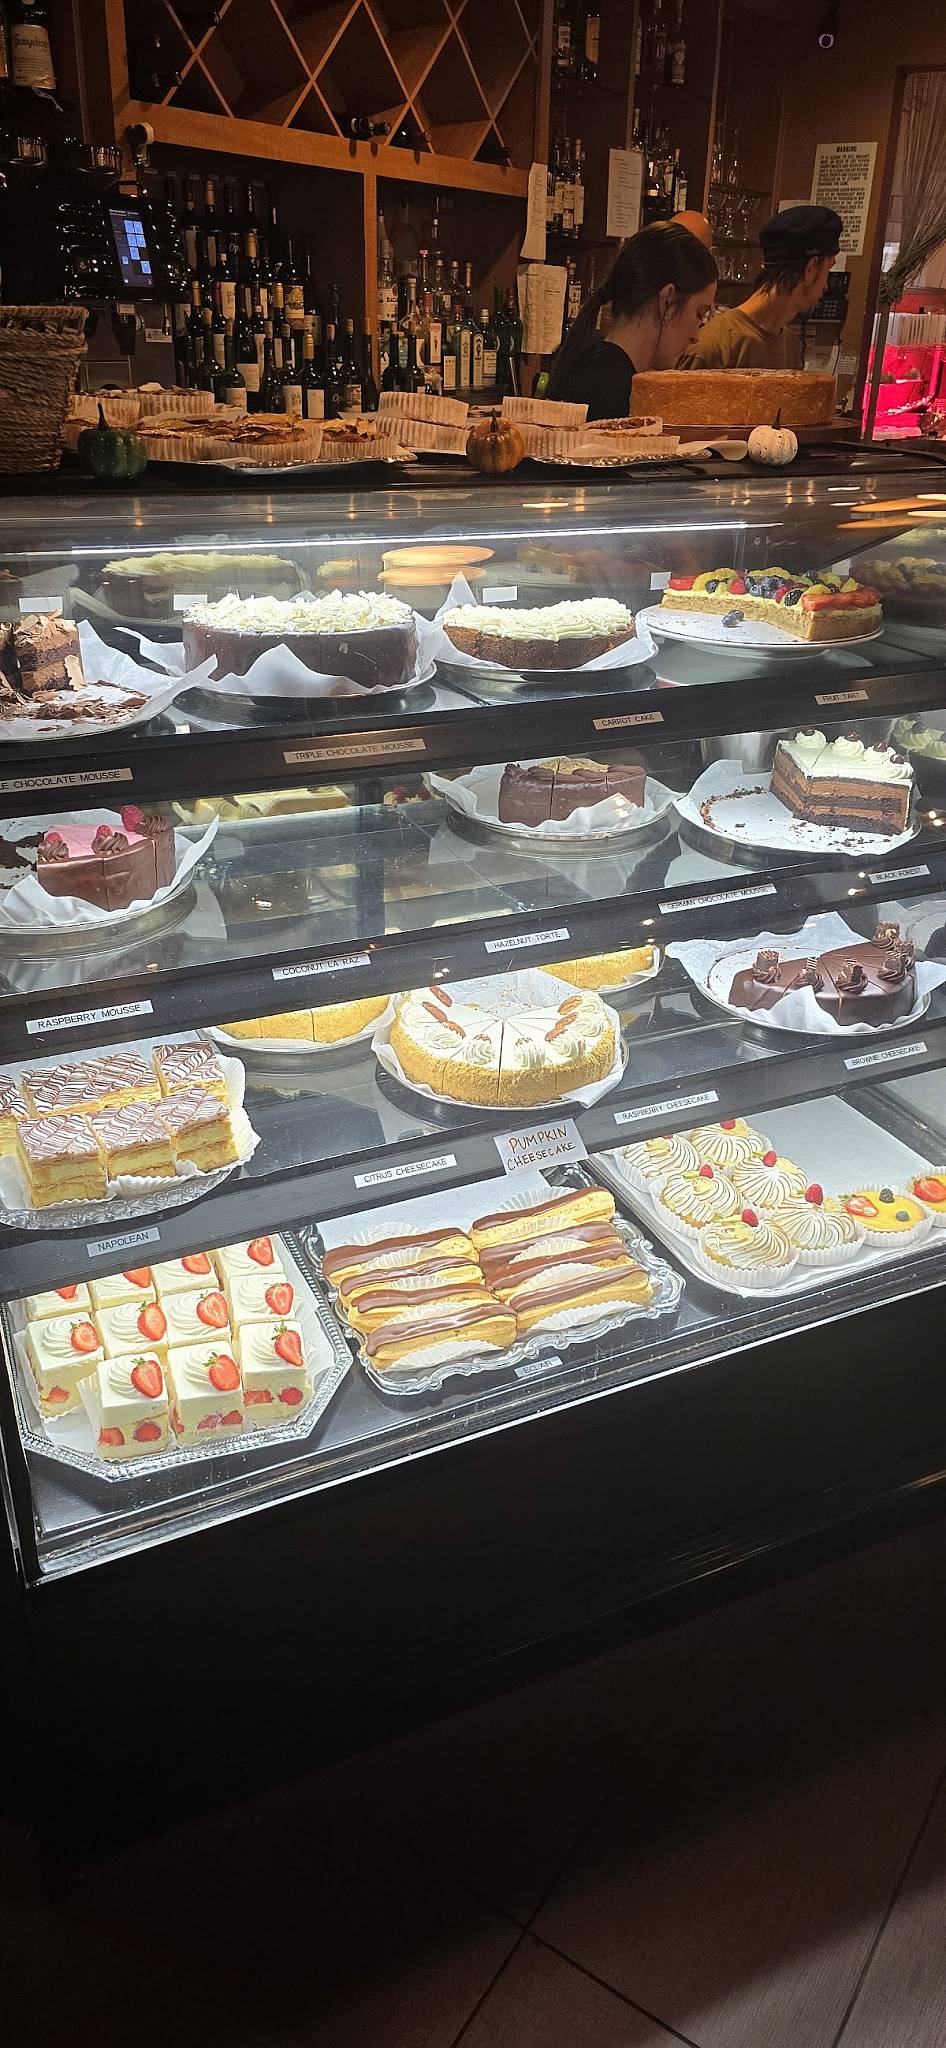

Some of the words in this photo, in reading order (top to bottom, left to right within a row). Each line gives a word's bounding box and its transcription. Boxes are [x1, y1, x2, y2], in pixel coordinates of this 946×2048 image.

[843, 692, 860, 700] TART
[602, 717, 632, 726] CARROT
[635, 714, 655, 722] CAKE
[294, 751, 323, 760] TRIPLE
[327, 745, 378, 756] CHOCOLATE
[382, 741, 416, 751] MOUSSE
[14, 775, 76, 788] CHOCOLATE
[80, 771, 120, 782] MOUSSE
[876, 872, 896, 880] BLACK
[899, 867, 920, 876] FOREST
[667, 899, 695, 910] GERMAN
[698, 891, 739, 905] CHOCOLATE
[740, 886, 769, 897] MOUSSE
[493, 936, 532, 949] HAZELNUT
[536, 931, 561, 941] TORTE
[282, 963, 324, 976] COCONUT
[328, 960, 340, 968] LA
[343, 956, 361, 965] RAZ
[37, 1012, 96, 1029] RASPBERRY
[101, 1004, 141, 1017] MOUSSE
[882, 1045, 920, 1059] CHEESECAKE
[622, 1105, 663, 1120] RASPBERRY
[666, 1094, 710, 1109] CHEESECAKE
[508, 1125, 567, 1154] PUMPKIN
[507, 1142, 576, 1171] CHEESECAKE
[364, 1171, 393, 1183] CITRUS
[396, 1158, 447, 1176] CHEESECAKE
[98, 1232, 149, 1251] NAPOLEAN
[523, 1360, 553, 1374] ECLAIR
